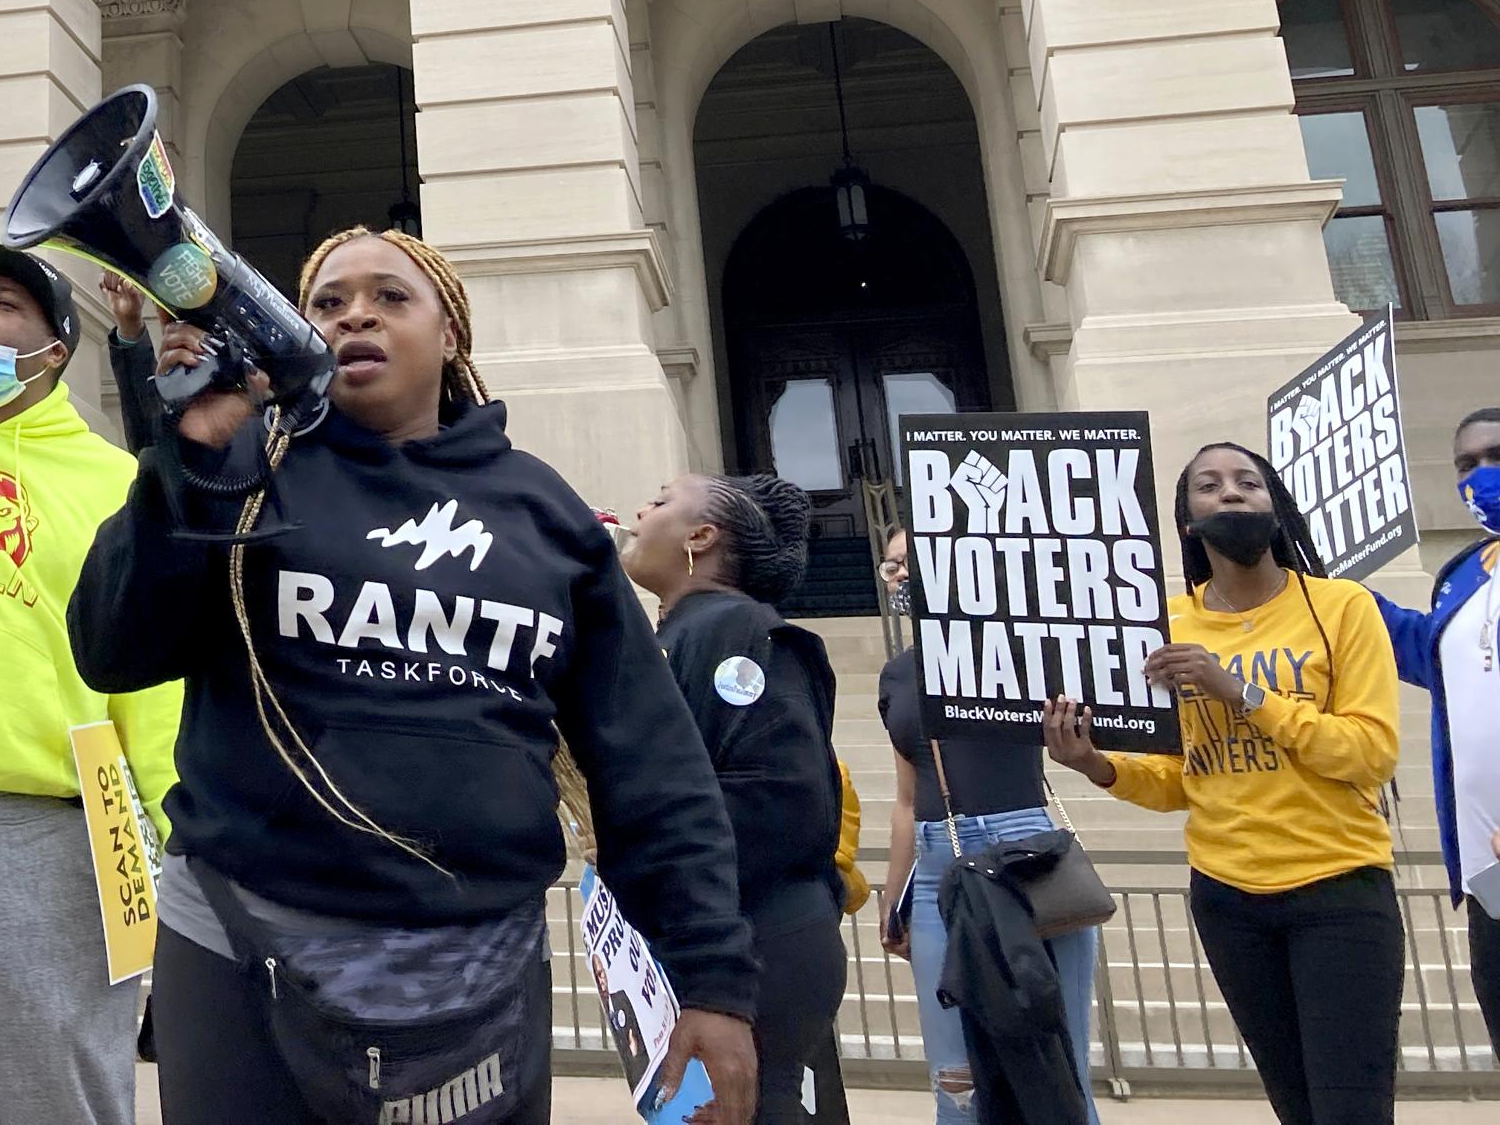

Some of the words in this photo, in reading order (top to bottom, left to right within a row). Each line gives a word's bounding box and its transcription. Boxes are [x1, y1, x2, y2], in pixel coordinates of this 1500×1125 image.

[160, 264, 193, 303] VOTE
[178, 250, 213, 292] FIGHT
[1302, 373, 1317, 389] YOU
[1346, 342, 1358, 355] WE
[906, 431, 910, 442] I
[914, 431, 966, 442] MATTER.
[969, 431, 998, 442] YOU
[1001, 430, 1056, 442] MATTER.
[1059, 430, 1081, 441] WE
[1085, 429, 1141, 441] MATTER.
[1308, 454, 1409, 565] ATTER
[913, 536, 1160, 622] VOTERS
[919, 618, 1172, 709] MATTER
[97, 766, 115, 815] TO
[109, 762, 151, 922] DEMAND
[110, 827, 137, 927] SCAN
[586, 884, 612, 940] MUS
[378, 1052, 504, 1125] PUMA
